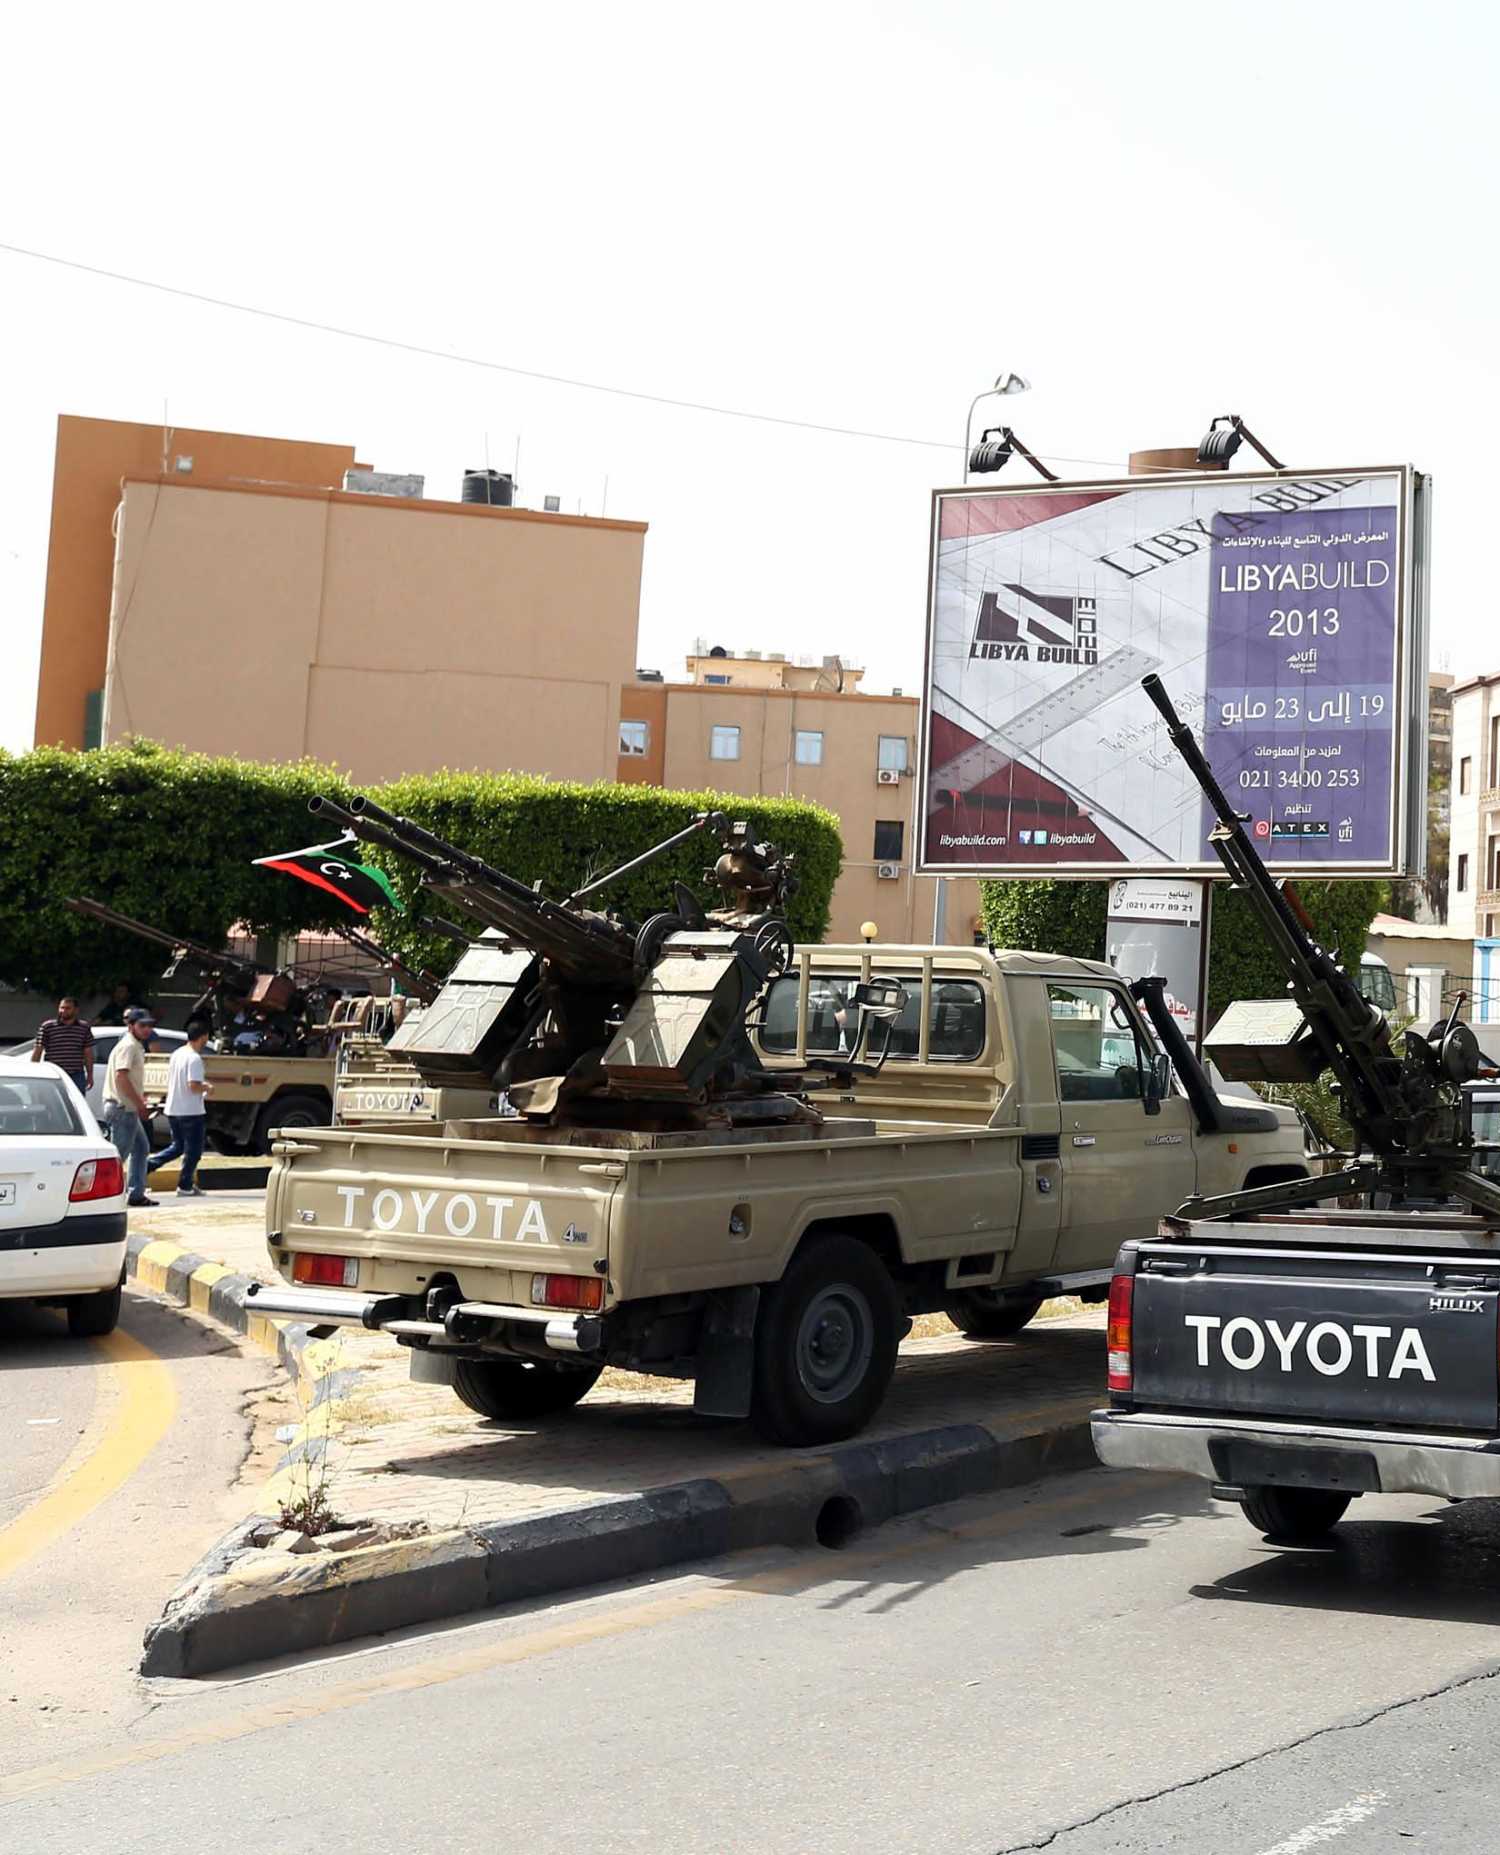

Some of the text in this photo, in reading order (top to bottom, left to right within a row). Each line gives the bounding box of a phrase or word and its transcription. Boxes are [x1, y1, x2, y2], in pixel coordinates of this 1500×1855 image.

[1293, 534, 1321, 549] التاسع
[1323, 533, 1352, 548] الدولي
[1353, 532, 1389, 544] المعرض
[1220, 560, 1390, 592] LIBYABUILD
[1268, 608, 1340, 636] 2013
[969, 642, 1098, 665] LIBYA BUILD
[1301, 648, 1317, 661] ufi
[1221, 694, 1267, 726] مايو
[1275, 698, 1300, 719] 23
[1308, 692, 1351, 724] إلى
[1359, 695, 1385, 716] 19
[1254, 745, 1342, 760] لمزيد من المعلومات
[1239, 769, 1360, 788] 021 3400 253
[1284, 803, 1313, 816] تنظيم
[1273, 823, 1328, 833] ATEX
[940, 834, 1006, 847] libyabuild.com
[1050, 832, 1097, 846] libyabuild
[1149, 902, 1166, 911] 477
[1181, 904, 1193, 913] 21
[337, 1186, 550, 1243] TOYOTA
[1429, 1297, 1485, 1312] HILUX
[1185, 1315, 1437, 1381] TOYOTA
